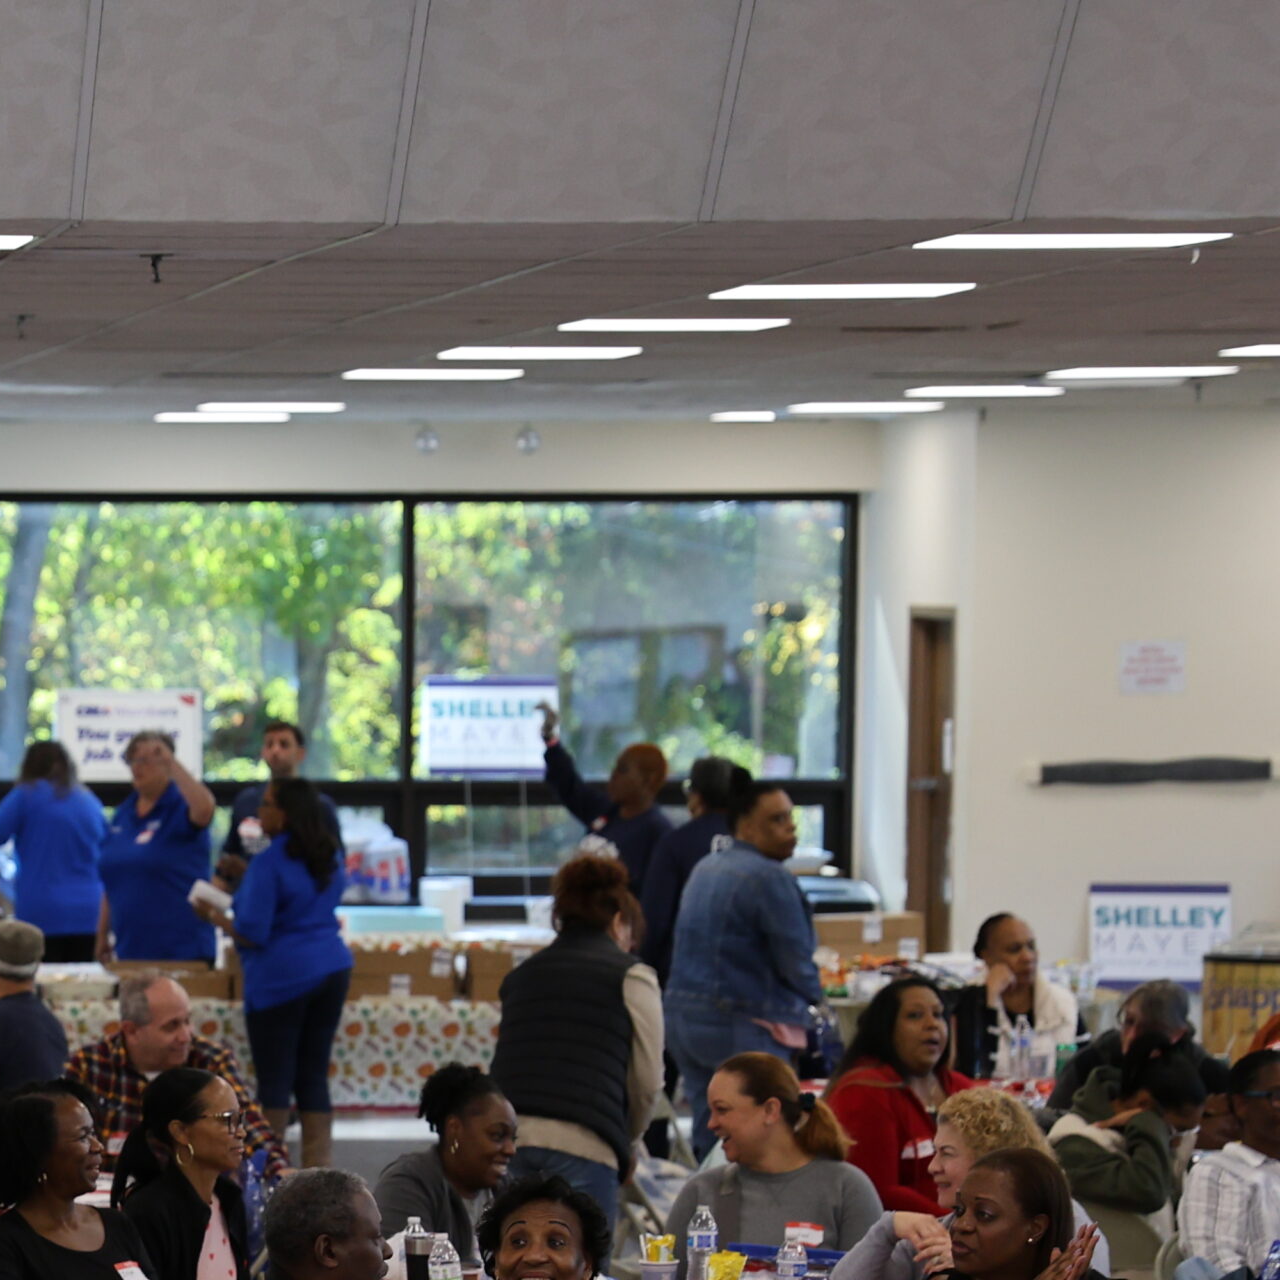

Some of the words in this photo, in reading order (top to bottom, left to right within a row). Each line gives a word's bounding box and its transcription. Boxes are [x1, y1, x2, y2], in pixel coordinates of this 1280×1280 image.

[431, 700, 535, 718] SHELLE
[430, 725, 525, 744] MAYE
[1095, 906, 1225, 927] SHELLEY
